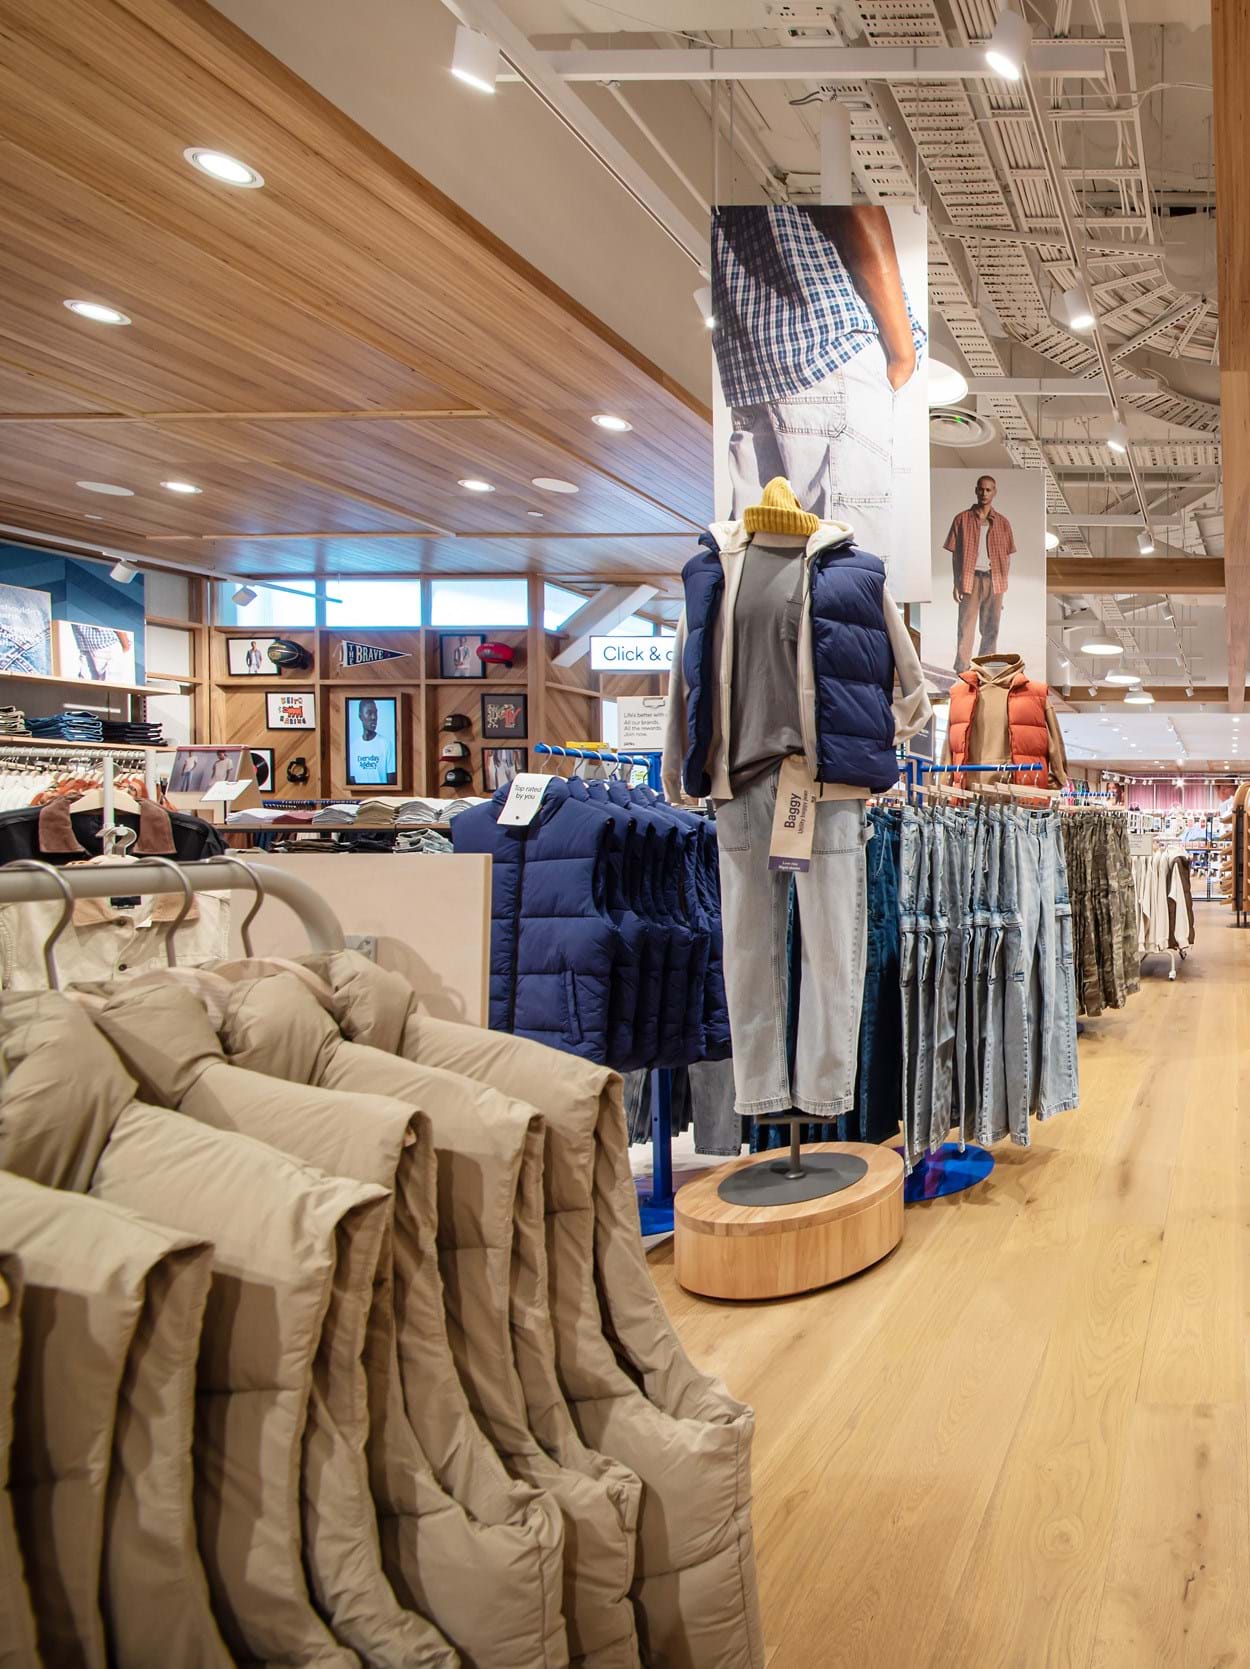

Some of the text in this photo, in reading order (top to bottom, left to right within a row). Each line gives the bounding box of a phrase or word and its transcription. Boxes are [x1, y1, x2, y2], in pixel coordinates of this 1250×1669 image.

[355, 645, 384, 663] BRAVE
[603, 645, 644, 661] Click
[649, 646, 662, 661] &
[515, 784, 543, 793] Top rated
[515, 792, 523, 800] by
[784, 793, 801, 829] Baggy
